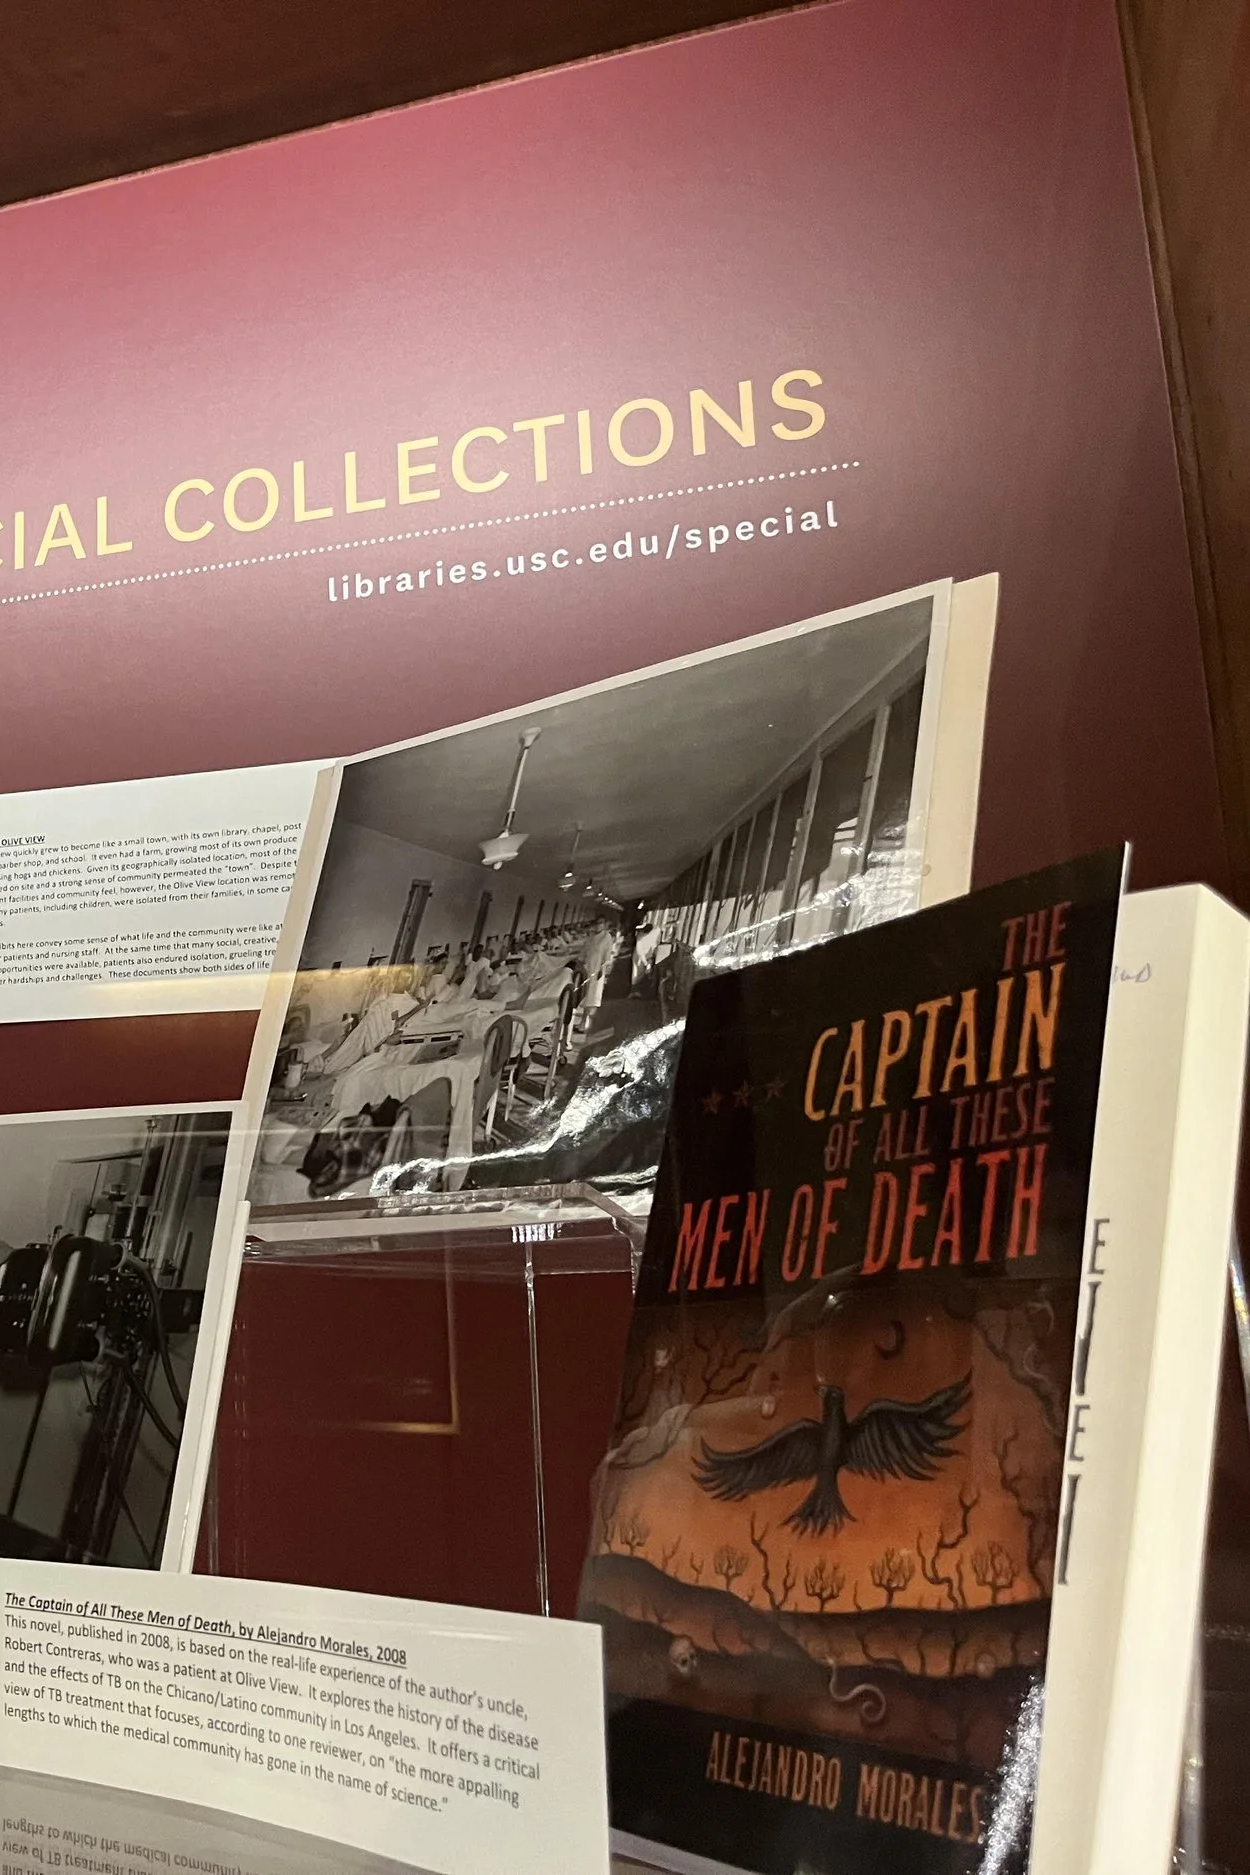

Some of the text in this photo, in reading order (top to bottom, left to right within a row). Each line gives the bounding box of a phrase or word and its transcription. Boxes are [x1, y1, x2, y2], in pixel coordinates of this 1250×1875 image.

[164, 369, 827, 542] COLLECTIONS
[328, 501, 840, 602] libraries.usc.edu/special
[0, 836, 23, 847] OLIVE
[24, 835, 45, 845] VIEW
[13, 872, 31, 880] hogs
[32, 868, 47, 878] and
[249, 849, 270, 858] most
[271, 847, 281, 856] of
[282, 846, 297, 855] the
[58, 865, 222, 887] strong sense of community permeated the
[164, 835, 297, 856] growing most of its own produce
[35, 940, 62, 948] convey
[63, 938, 85, 946] some
[86, 936, 108, 944] sense
[109, 933, 119, 942] of
[119, 933, 140, 941] what
[141, 931, 154, 940] life
[155, 930, 171, 939] and
[172, 929, 186, 938] the
[187, 927, 234, 937] community
[235, 925, 257, 933] were
[104, 941, 214, 955] At the same time that many
[107, 959, 270, 978] These documents show both sides of life
[1001, 901, 1073, 973] THE
[804, 963, 1066, 1122] CAPTAIN
[823, 1078, 1055, 1172] OF ALL THESE
[668, 1188, 771, 1293] MEN
[782, 1176, 848, 1283] OF
[860, 1143, 1049, 1276] DEATH
[4, 1613, 27, 1629] This
[29, 1619, 64, 1636] novel,
[67, 1623, 123, 1642] published
[126, 1629, 137, 1644] in
[140, 1631, 173, 1652] 2008,
[176, 1636, 186, 1652] is
[189, 1638, 225, 1658] based
[228, 1648, 244, 1660] on
[247, 1647, 268, 1664] the
[271, 1653, 316, 1674] real-life
[319, 1663, 385, 1688] experience
[388, 1674, 402, 1690] of
[404, 1677, 426, 1696] the
[486, 1698, 527, 1721] uncle,
[5, 1591, 406, 1664] The Captain of All These Men of Death, by Alejandro Morales, 2008
[4, 1635, 538, 1751] Robert Contreras, who was a patient at Olive View. It explores the history of the disease
[4, 1659, 539, 1780] and the effects of TB on the Chicano/Latino community in Los Angeles. It offers a critical
[3, 1680, 30, 1696] view
[32, 1685, 46, 1699] of
[46, 1686, 62, 1702] TB
[64, 1690, 125, 1713] treatment
[127, 1699, 152, 1718] that
[154, 1704, 203, 1730] focuses,
[206, 1717, 264, 1743] according
[268, 1728, 280, 1743] to
[283, 1734, 306, 1749] one
[309, 1739, 365, 1767] reviewer,
[368, 1754, 384, 1768] on
[419, 1766, 454, 1787] more
[457, 1776, 519, 1809] appalling
[3, 1701, 45, 1722] lengths
[47, 1711, 60, 1724] to
[62, 1713, 97, 1732] which
[100, 1719, 119, 1735] the
[123, 1726, 169, 1744] medical
[172, 1735, 241, 1763] community
[244, 1745, 264, 1765] has
[266, 1755, 296, 1773] gone
[300, 1760, 311, 1777] in
[314, 1763, 334, 1783] the
[337, 1773, 371, 1793] name
[374, 1780, 388, 1796] of
[706, 1730, 987, 1845] ALEJANDRO MORALES
